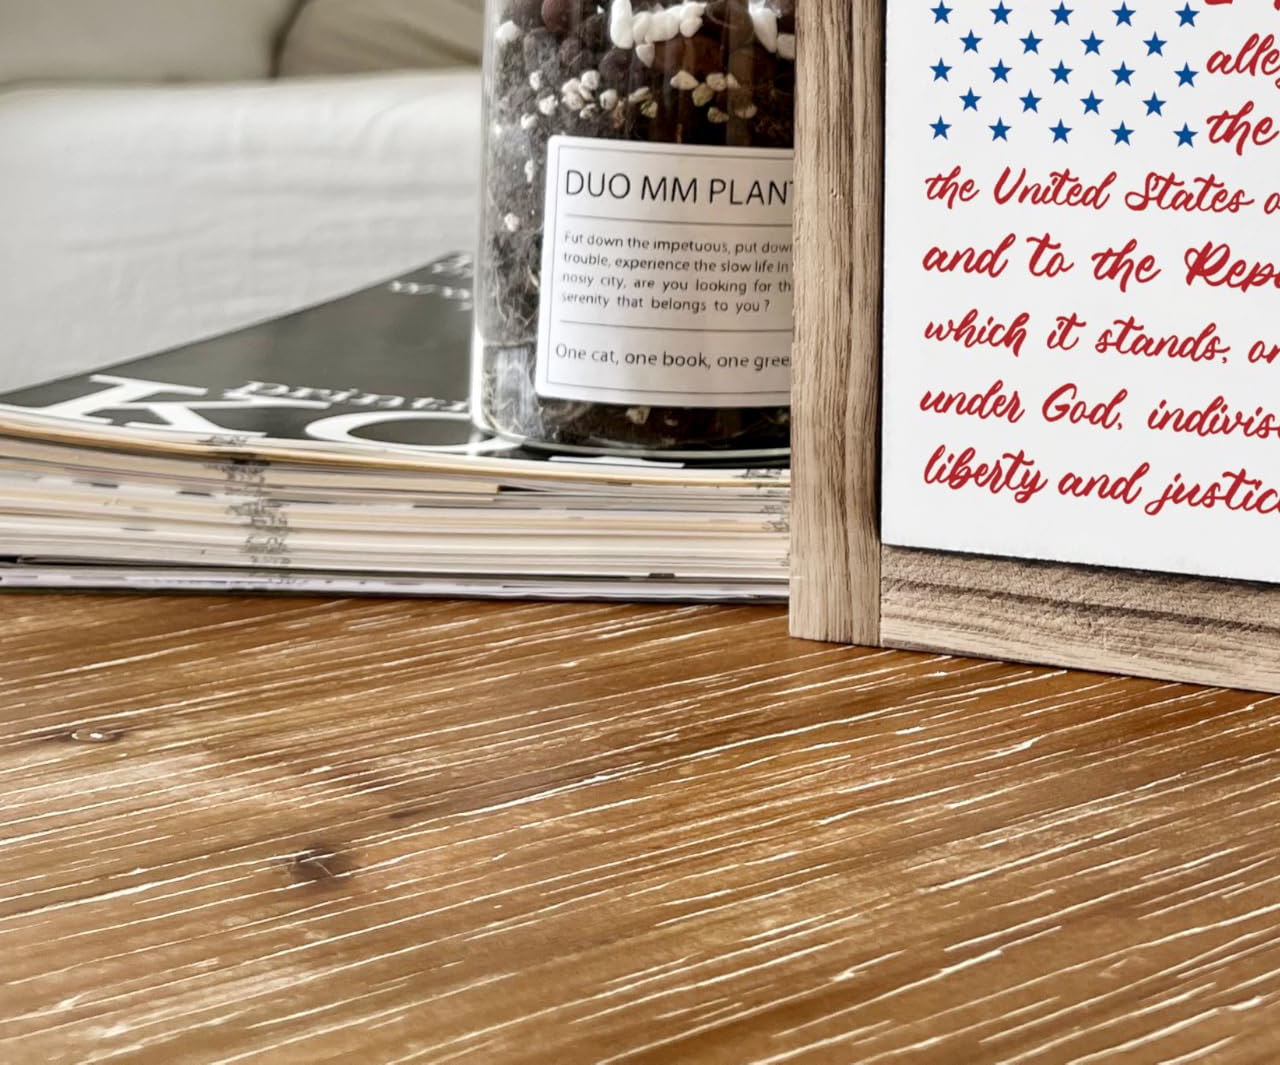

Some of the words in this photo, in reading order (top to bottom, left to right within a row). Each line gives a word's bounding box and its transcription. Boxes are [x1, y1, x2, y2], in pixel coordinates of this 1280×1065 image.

[1206, 100, 1280, 156] the
[566, 170, 631, 200] DUO
[641, 175, 698, 203] MM
[709, 178, 794, 206] PLAN
[925, 165, 979, 210] the
[993, 168, 1117, 211] United
[1124, 172, 1255, 214] States
[564, 252, 612, 268] trouble,
[615, 257, 691, 271] experience
[694, 259, 718, 273] the
[721, 260, 752, 273] slow
[754, 260, 775, 273] life
[777, 261, 789, 273] in
[587, 234, 623, 247] down
[627, 237, 650, 250] the
[653, 238, 731, 255] impetuous,
[735, 241, 758, 256] put
[922, 233, 1017, 279] and
[1025, 233, 1074, 279] to
[1091, 239, 1161, 294] the
[561, 292, 610, 309] serenity
[617, 296, 645, 310] that
[651, 297, 707, 315] belongs
[714, 300, 729, 313] to
[600, 276, 627, 290] city,
[633, 279, 656, 290] are
[662, 280, 689, 293] you
[695, 280, 748, 296] looking
[754, 279, 773, 293] for
[778, 280, 792, 294] th
[924, 308, 1031, 358] which
[1047, 312, 1088, 351] it
[1095, 316, 1231, 363] stands,
[556, 343, 587, 360] One
[591, 348, 620, 366] cat,
[624, 352, 658, 366] one
[662, 351, 712, 370] book,
[717, 355, 750, 368] one
[753, 356, 792, 371] gree
[919, 379, 1025, 424] under
[1042, 382, 1129, 431] God,
[924, 444, 1049, 504] liberty
[1057, 462, 1151, 505] and
